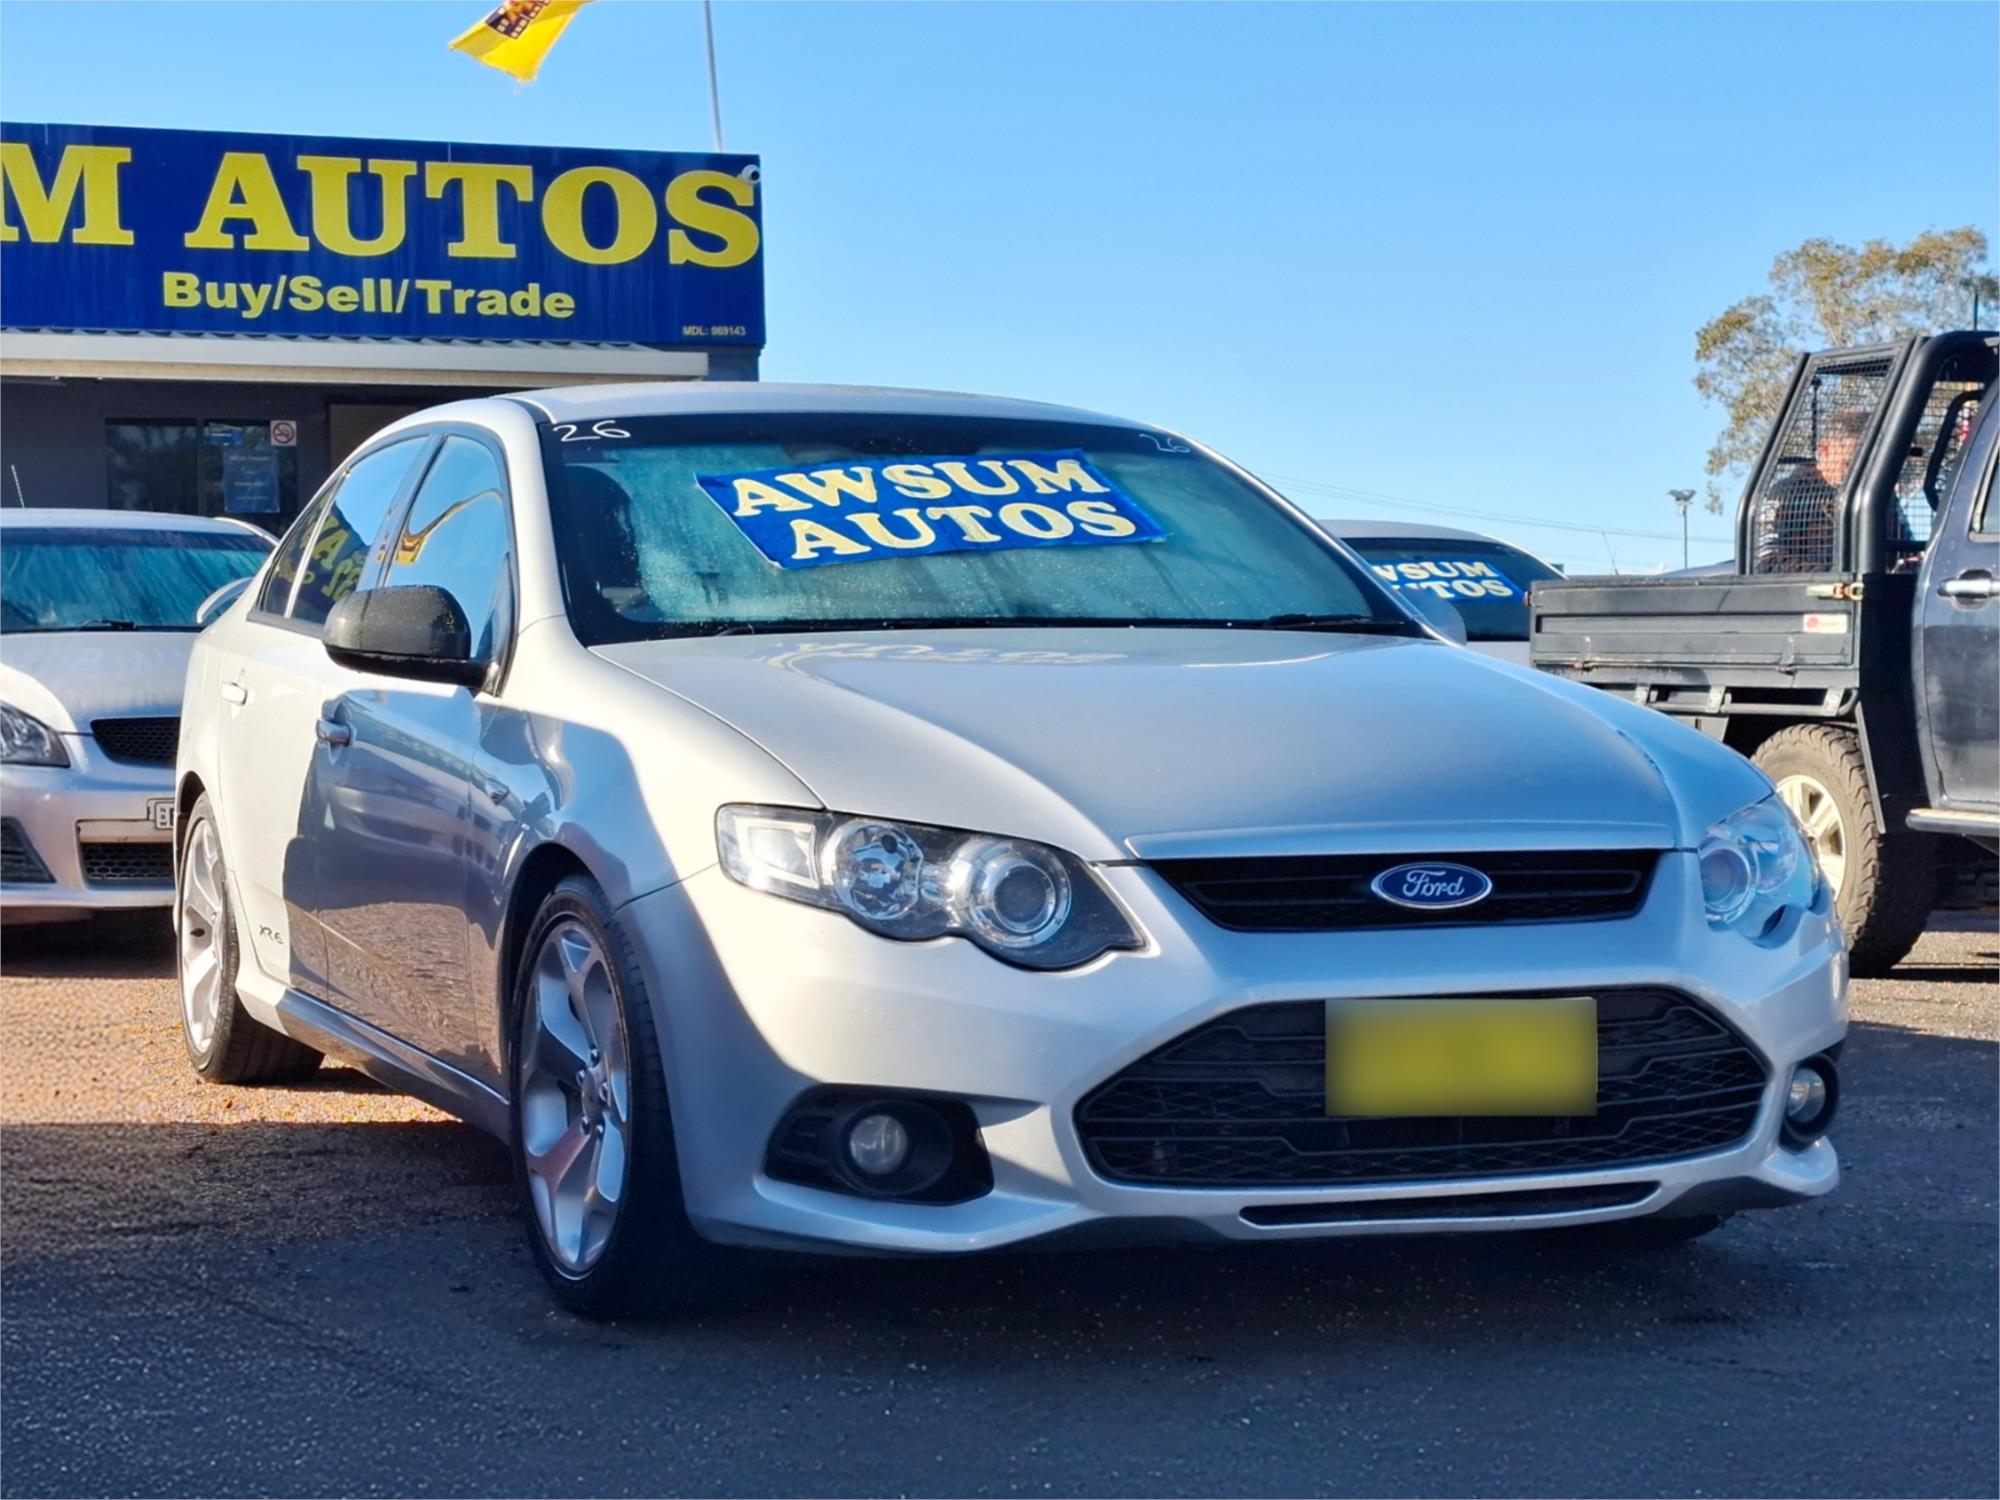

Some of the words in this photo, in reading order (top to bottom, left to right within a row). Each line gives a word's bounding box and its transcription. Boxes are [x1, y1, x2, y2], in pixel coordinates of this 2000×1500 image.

[184, 152, 760, 268] AUTOS
[163, 271, 576, 319] Buy/Sell/Trade
[552, 420, 631, 441] 26
[733, 459, 1111, 517] AWSUM
[788, 501, 1137, 560] AUTOS
[1391, 579, 1514, 599] TOS
[1402, 869, 1465, 897] Ford
